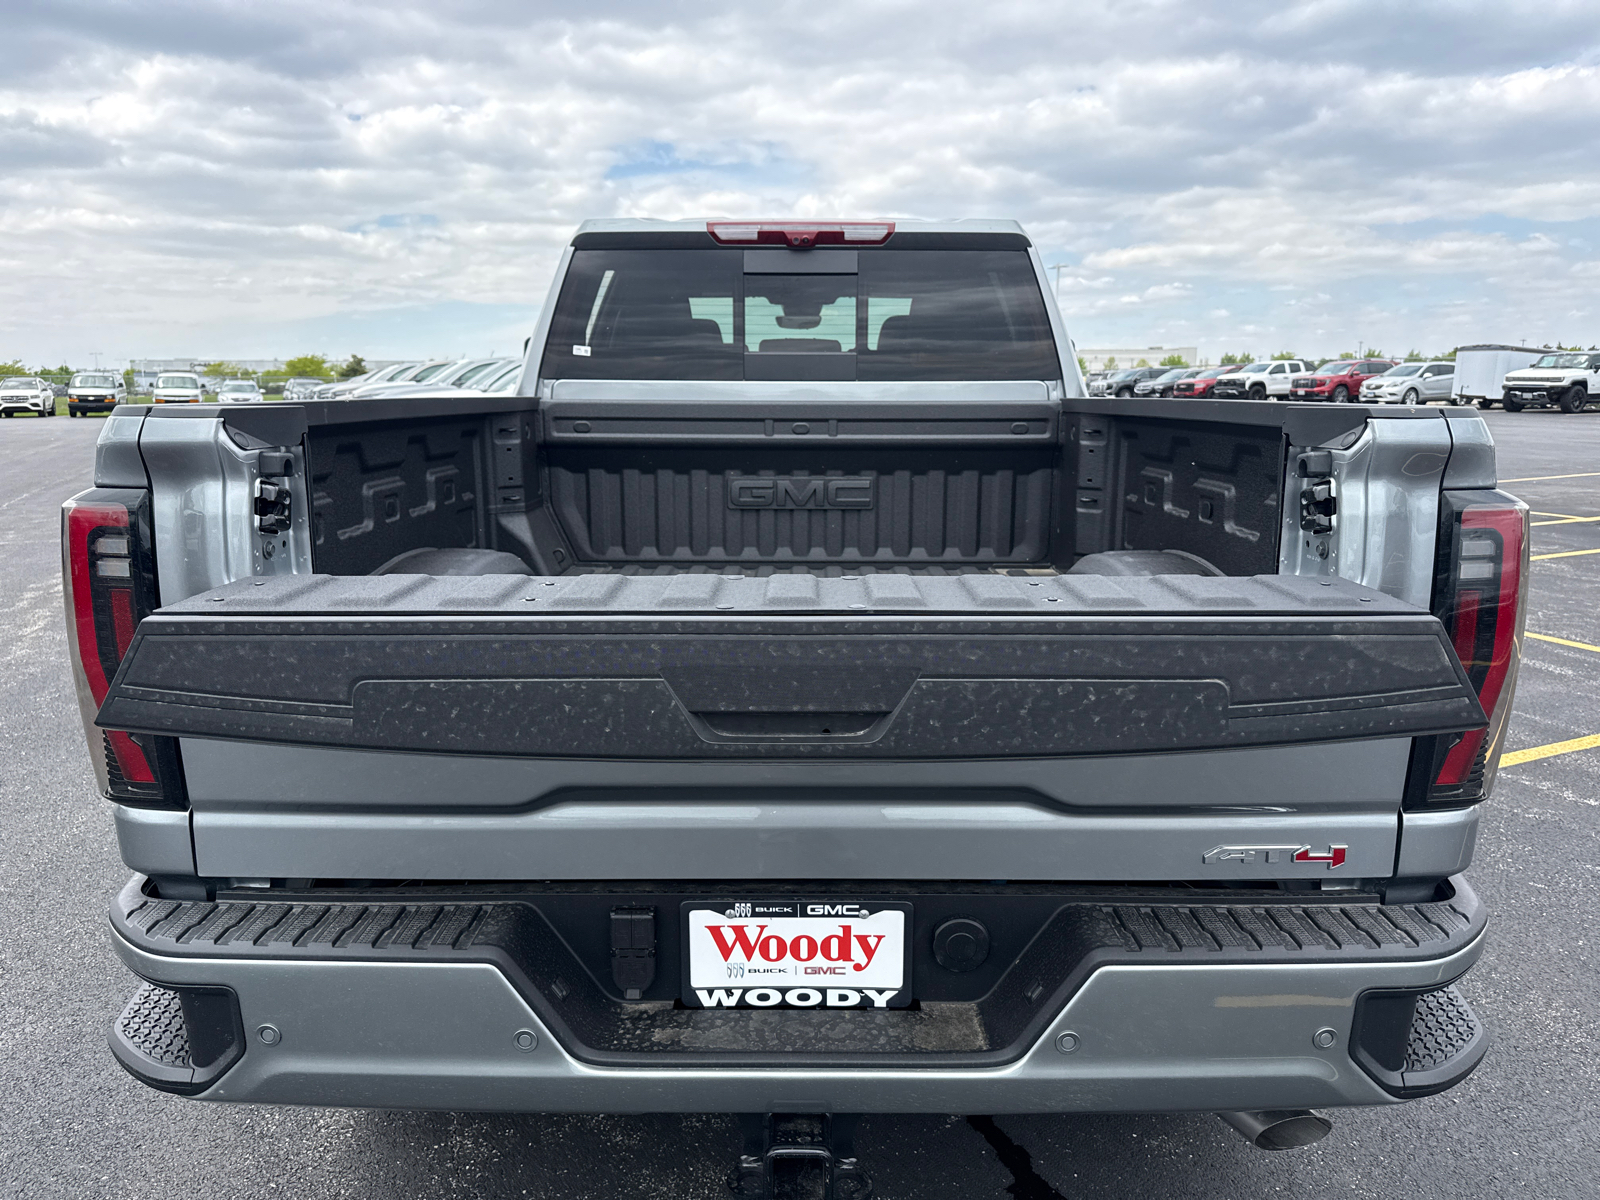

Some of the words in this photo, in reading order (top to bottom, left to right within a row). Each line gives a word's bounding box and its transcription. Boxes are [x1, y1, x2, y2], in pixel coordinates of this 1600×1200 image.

[730, 480, 871, 507] GMC
[1202, 843, 1349, 870] AT4
[806, 904, 860, 916] GMC
[704, 925, 886, 972] Woody
[803, 966, 847, 976] GMC
[695, 988, 899, 1008] WOODY
